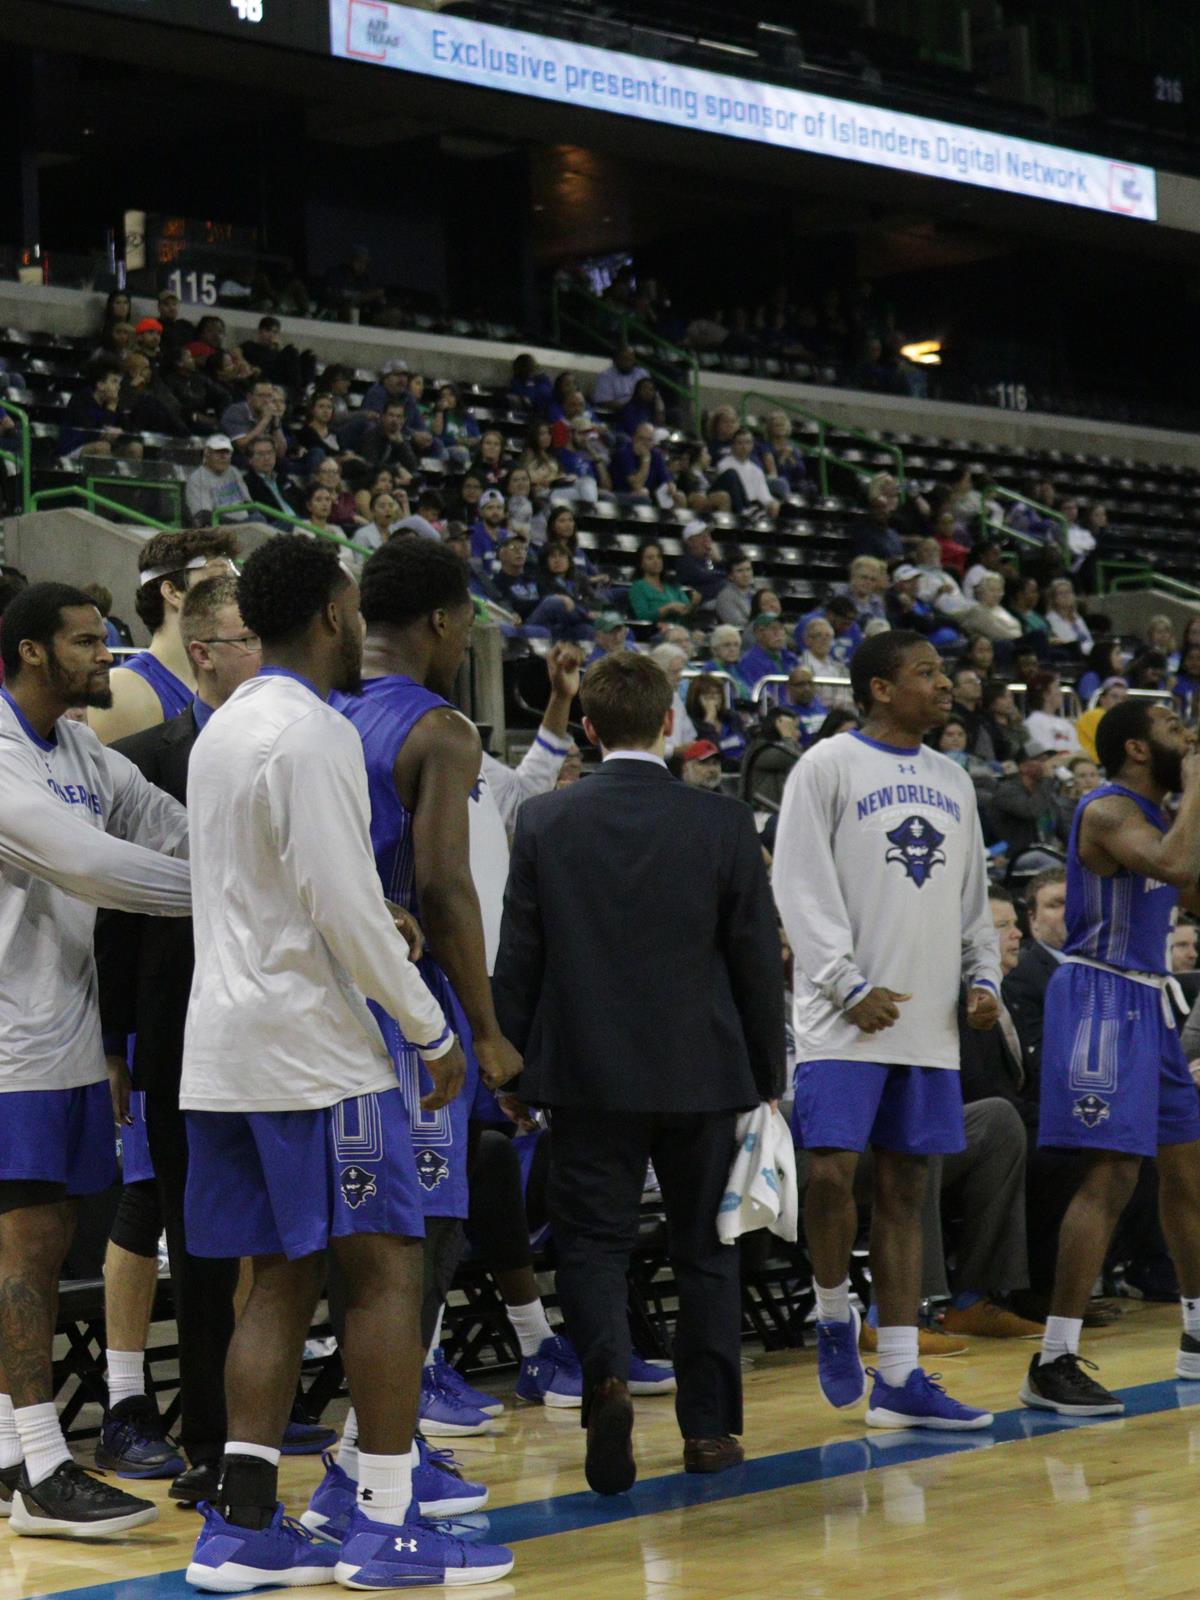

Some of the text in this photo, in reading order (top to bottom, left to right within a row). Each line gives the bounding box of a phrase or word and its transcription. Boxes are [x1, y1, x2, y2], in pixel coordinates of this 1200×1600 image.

[432, 29, 557, 83] Exclusive
[565, 64, 698, 119] presenting
[705, 93, 798, 131] sponsor
[804, 111, 826, 138] of
[831, 115, 930, 160] Islanders
[936, 136, 1001, 176] Digital
[1006, 151, 1089, 194] Network
[170, 269, 218, 306] 115
[857, 784, 961, 823] NEW ORLEANS
